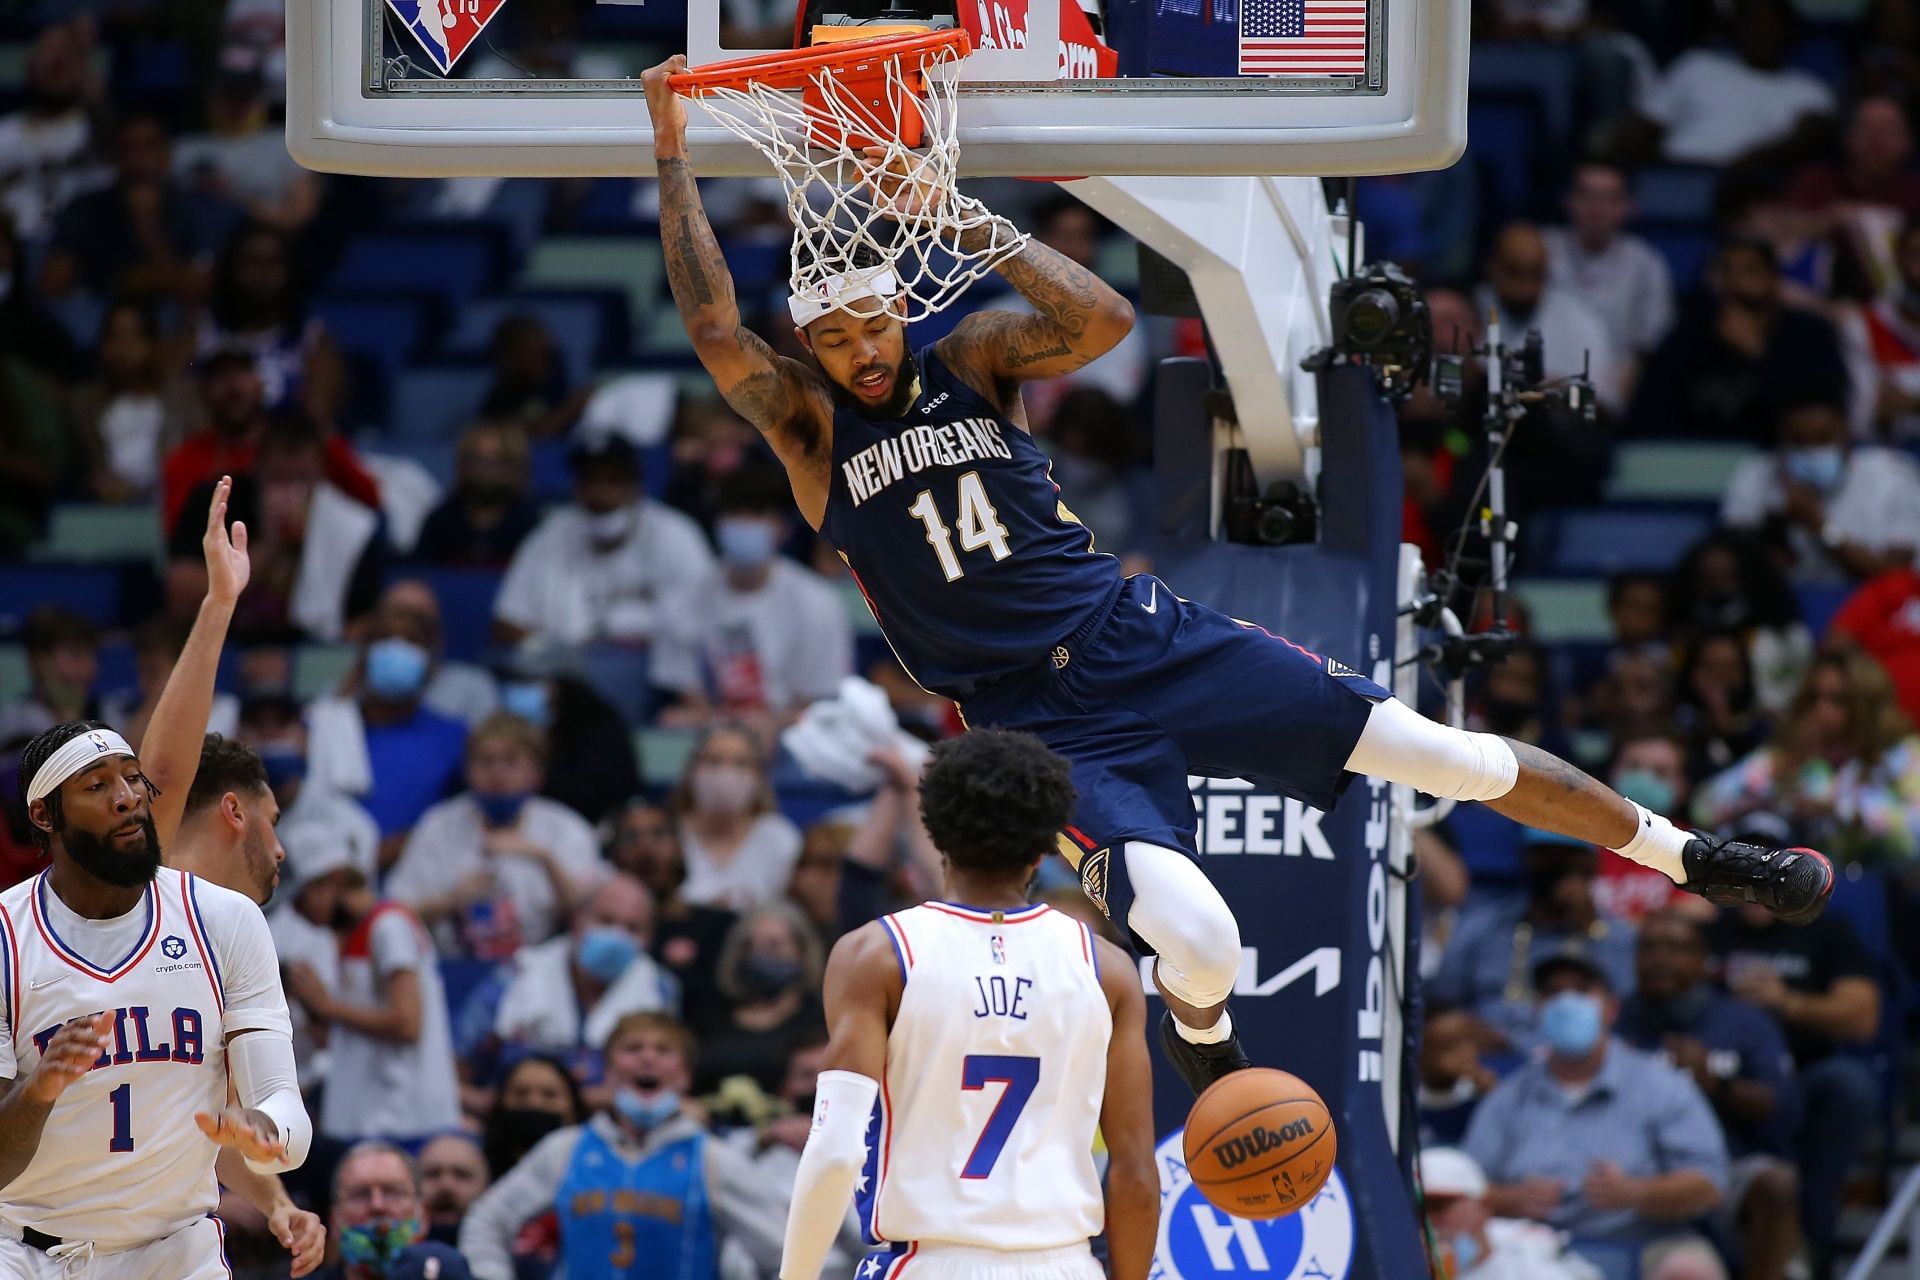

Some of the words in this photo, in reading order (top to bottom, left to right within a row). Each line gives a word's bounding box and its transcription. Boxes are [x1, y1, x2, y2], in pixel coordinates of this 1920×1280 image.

[921, 392, 950, 414] otta
[842, 438, 904, 508] NEW
[908, 471, 1012, 582] 14
[1195, 796, 1335, 860] EEK
[155, 962, 202, 974] crypto.com
[974, 976, 1032, 1020] JOE
[33, 1006, 204, 1071] ILA
[110, 1083, 134, 1153] 1
[960, 1055, 1040, 1179] 7
[1212, 1117, 1314, 1170] Wilson
